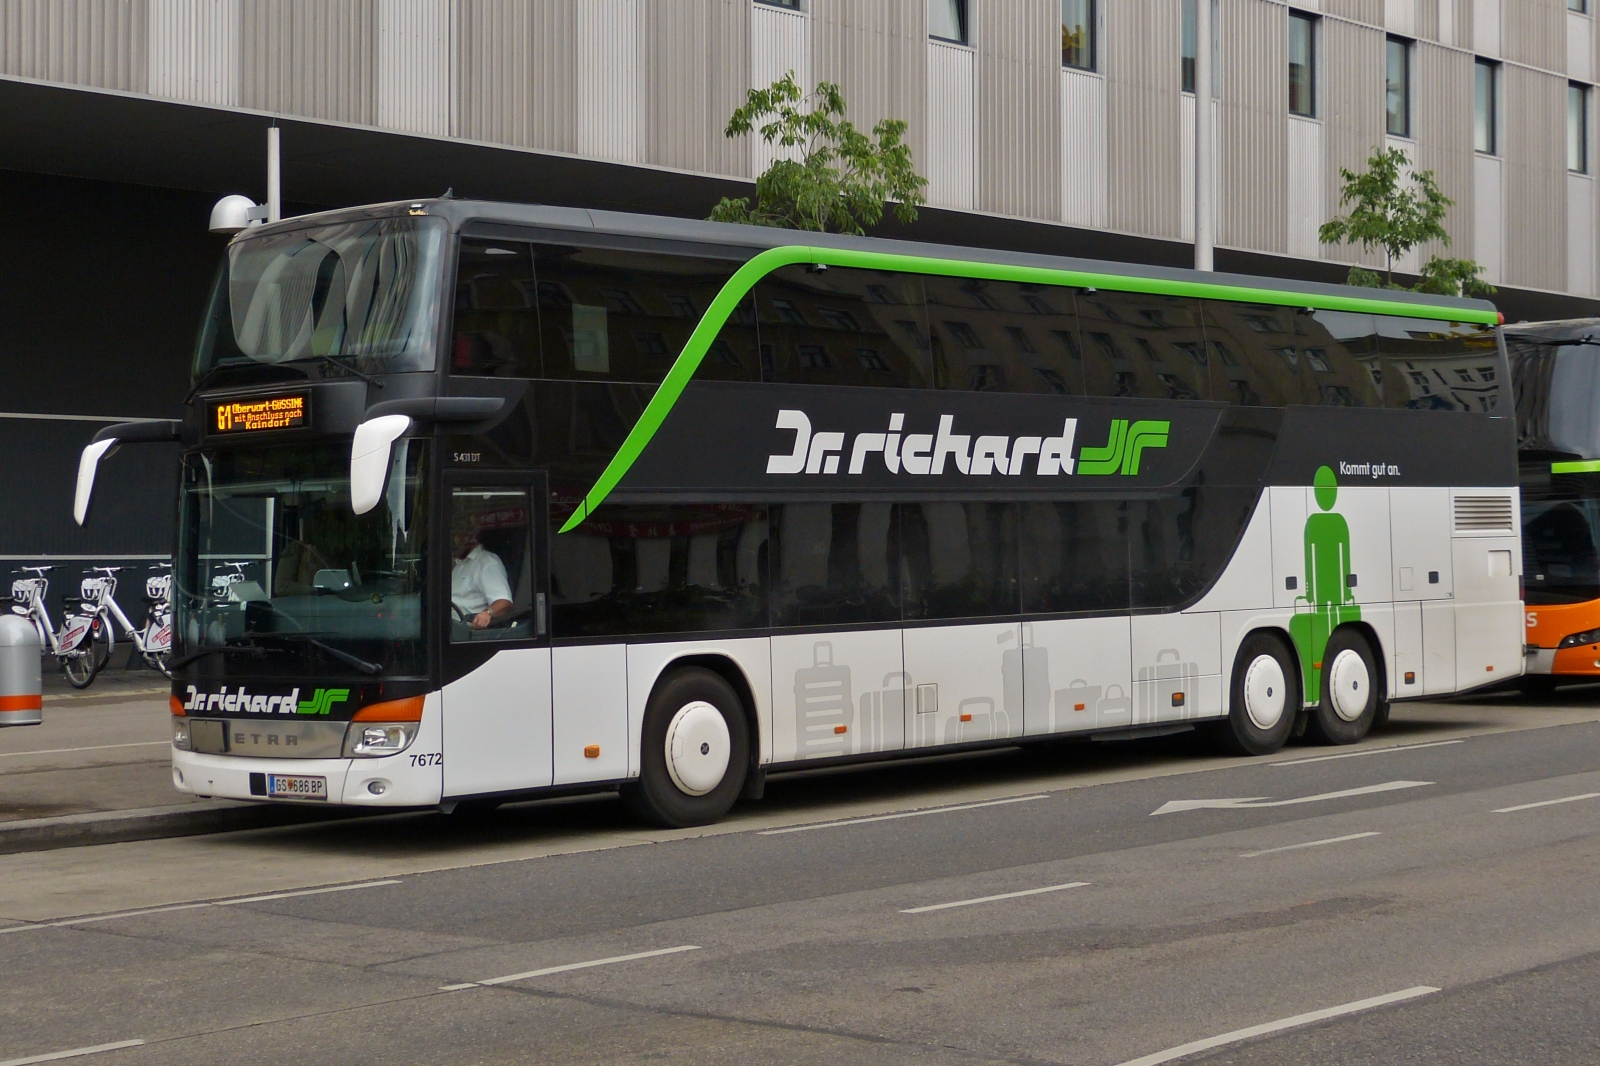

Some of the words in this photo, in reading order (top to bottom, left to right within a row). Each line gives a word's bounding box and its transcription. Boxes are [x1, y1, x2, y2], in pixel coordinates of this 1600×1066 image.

[217, 405, 232, 430] G1
[247, 411, 283, 422] Anschluss
[284, 409, 302, 418] nach
[245, 418, 290, 430] Kaindorf
[1339, 461, 1370, 475] Kommt
[1372, 462, 1386, 479] gut
[1387, 465, 1401, 476] an.
[409, 753, 442, 767] 7672
[276, 779, 287, 792] GS
[311, 780, 322, 793] BP
